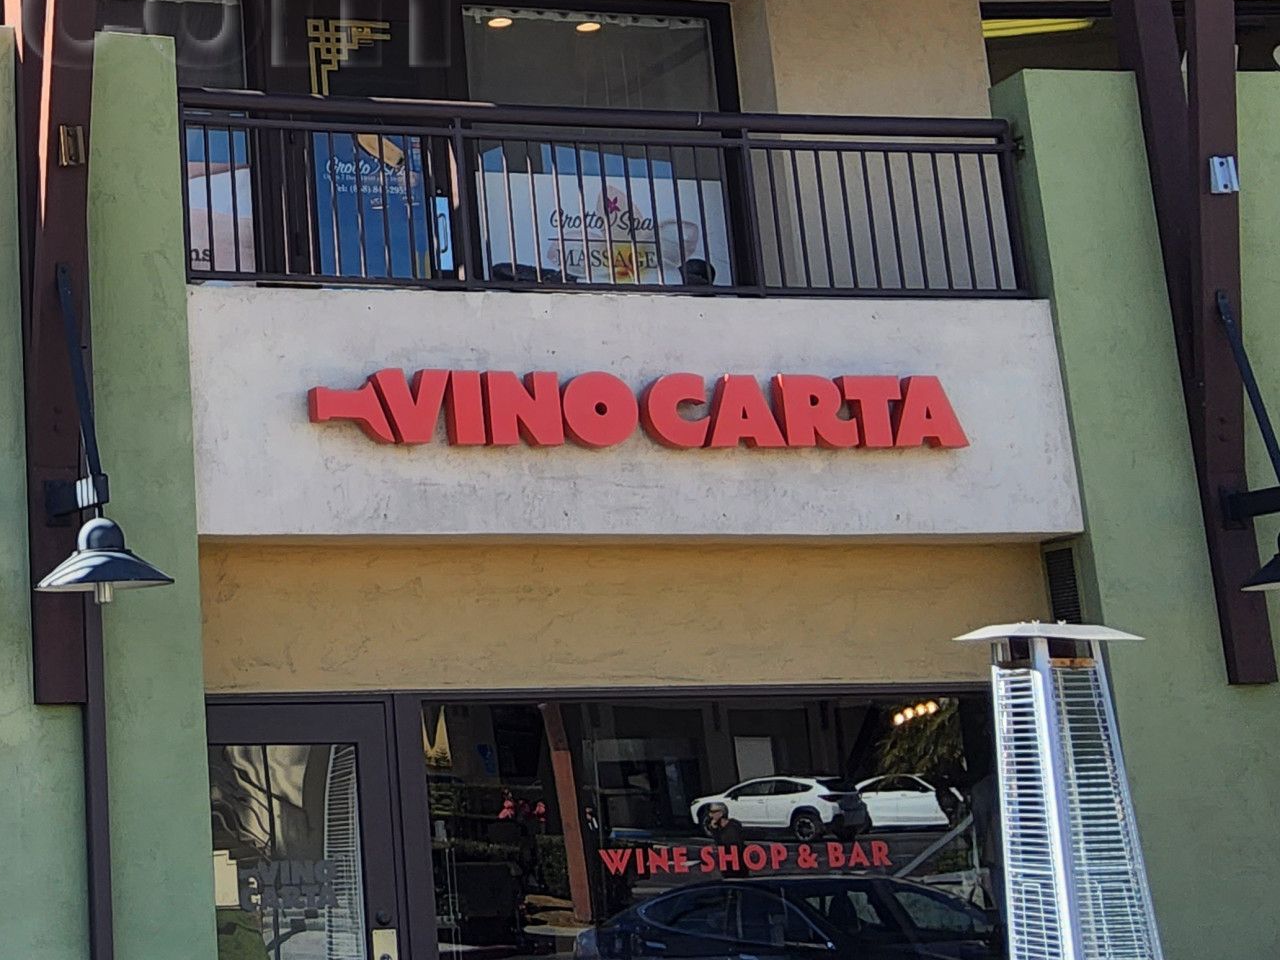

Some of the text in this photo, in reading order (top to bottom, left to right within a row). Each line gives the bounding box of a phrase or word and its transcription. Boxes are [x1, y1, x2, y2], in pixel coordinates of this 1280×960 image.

[550, 208, 606, 229] Grotto
[556, 248, 659, 269] MASSAGE
[598, 840, 893, 875] WINE SHOP & BAR
